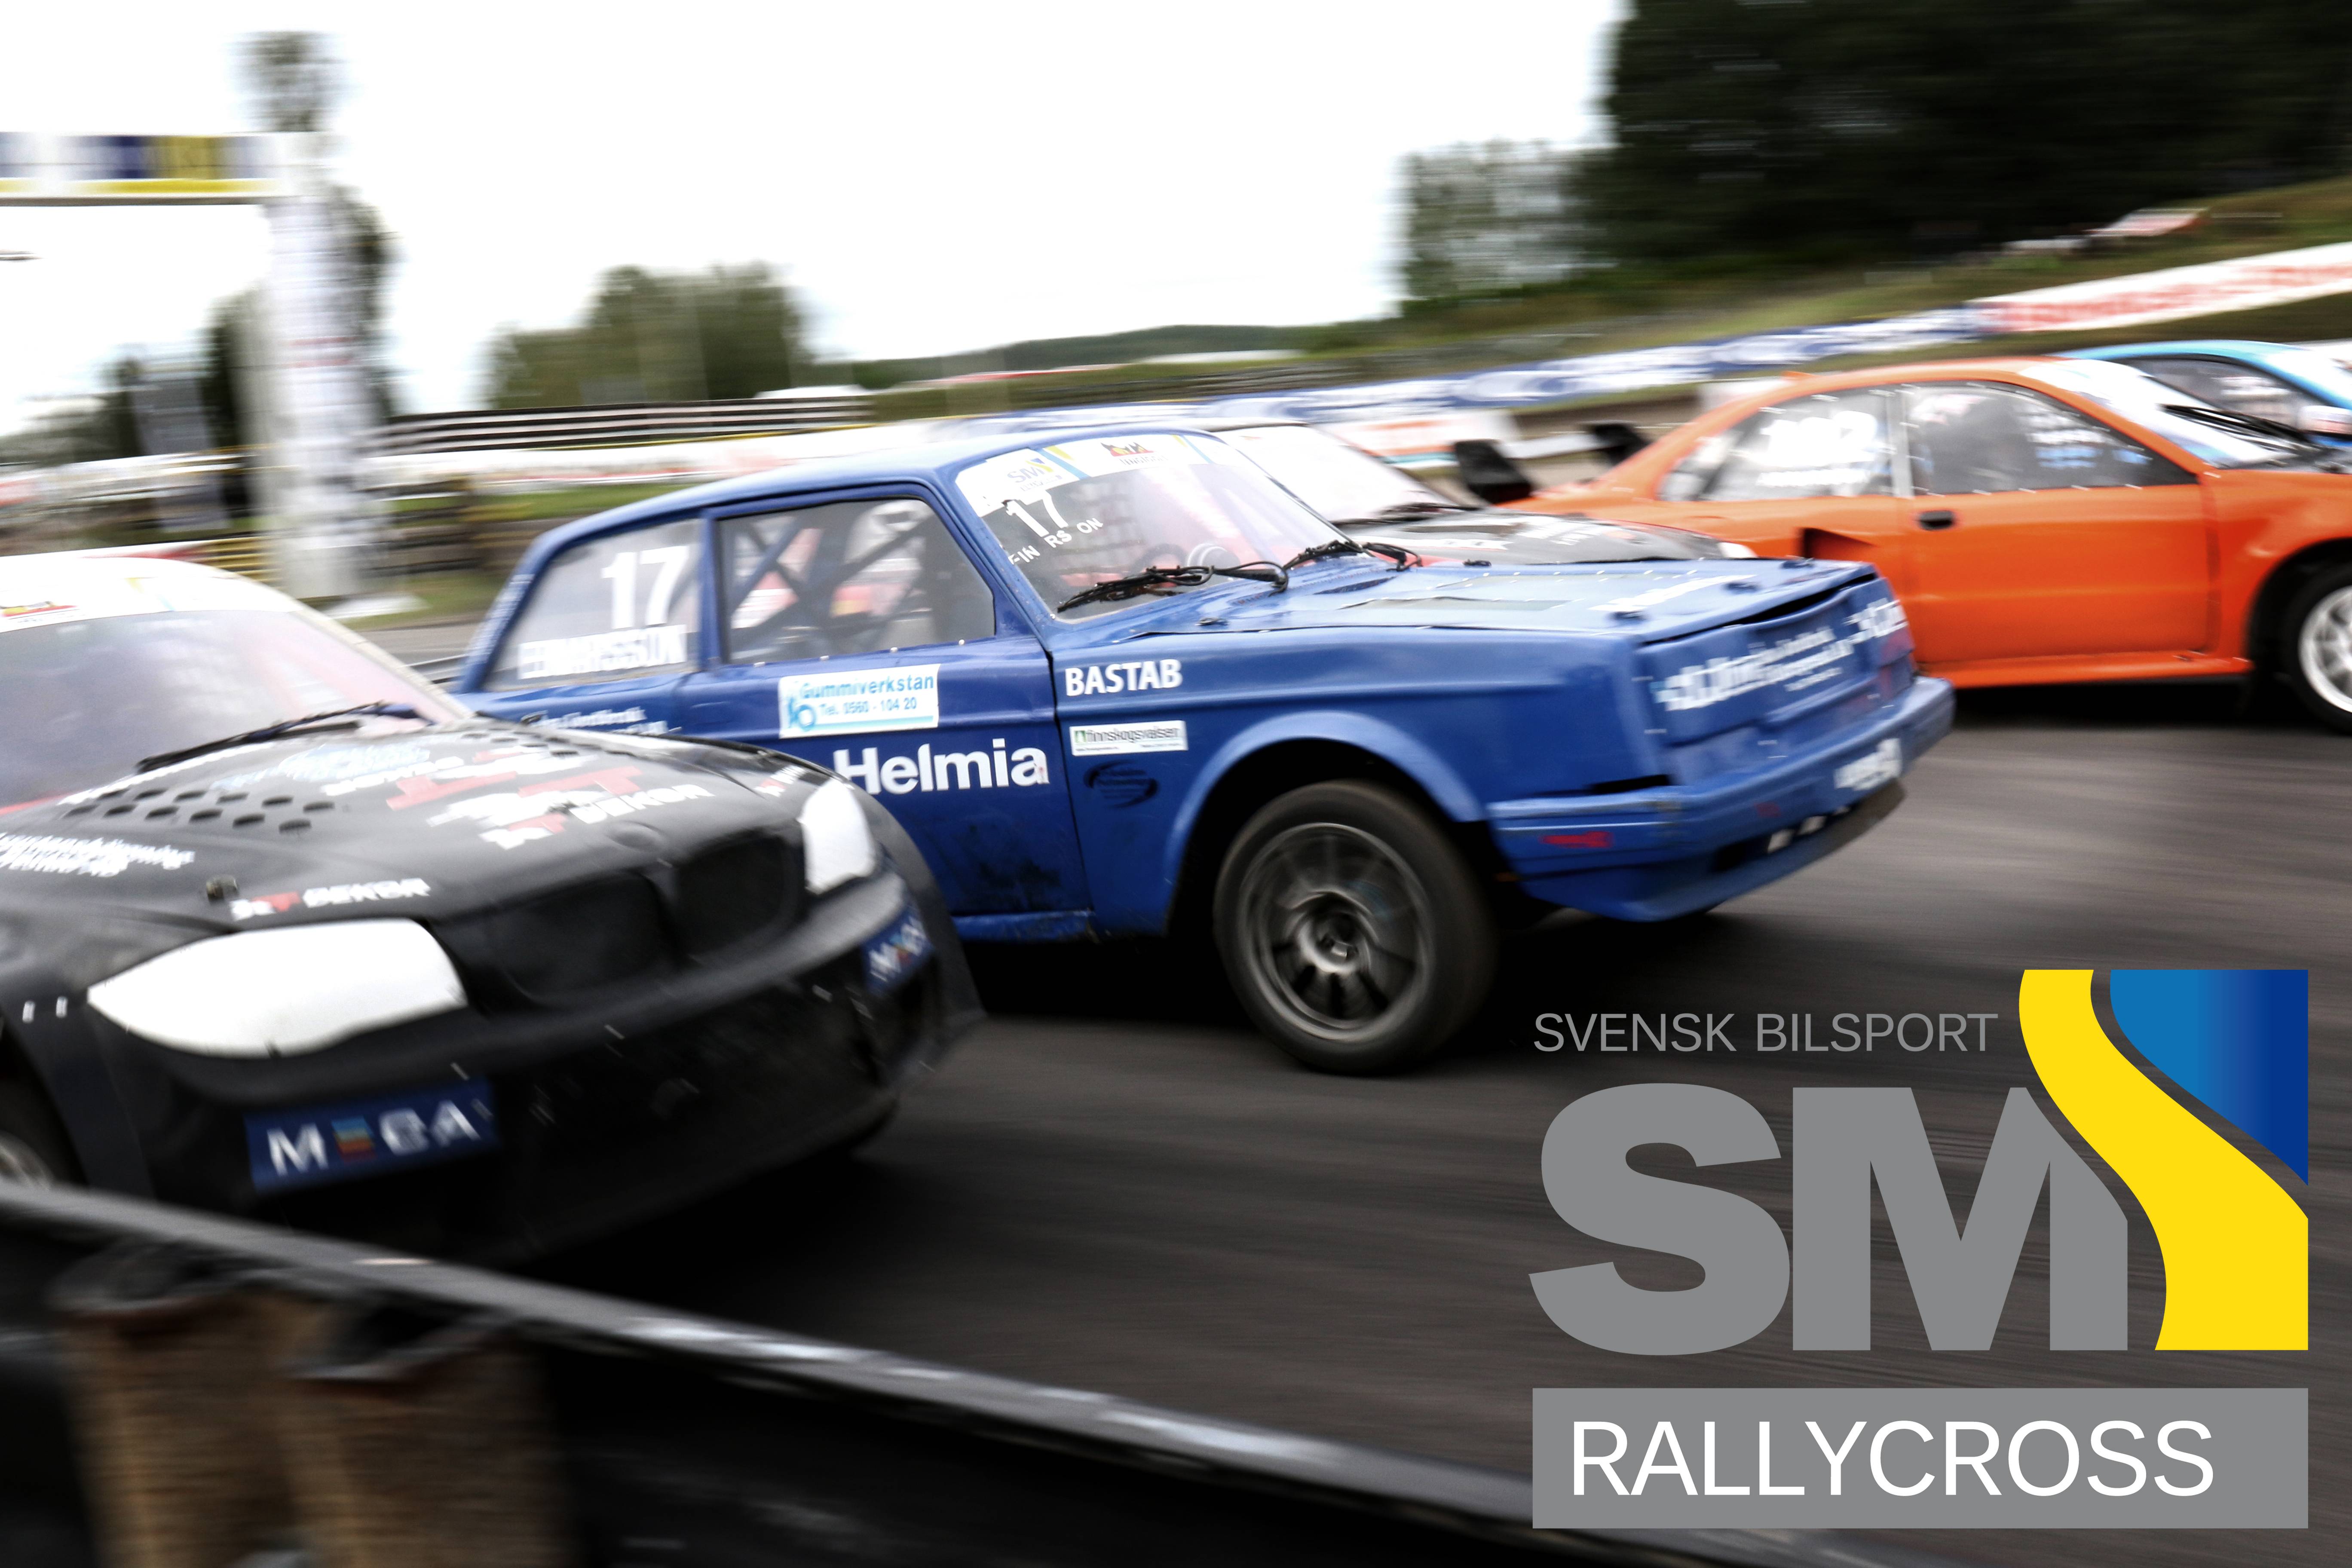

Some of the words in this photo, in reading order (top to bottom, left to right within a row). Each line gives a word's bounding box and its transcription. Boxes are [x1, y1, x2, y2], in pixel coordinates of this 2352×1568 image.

[601, 545, 690, 630] 17
[800, 674, 934, 700] Gummiverkstan
[1065, 658, 1183, 697] BASTAB
[881, 698, 900, 712] 104
[903, 696, 917, 710] 20
[833, 738, 1050, 795] Helmia
